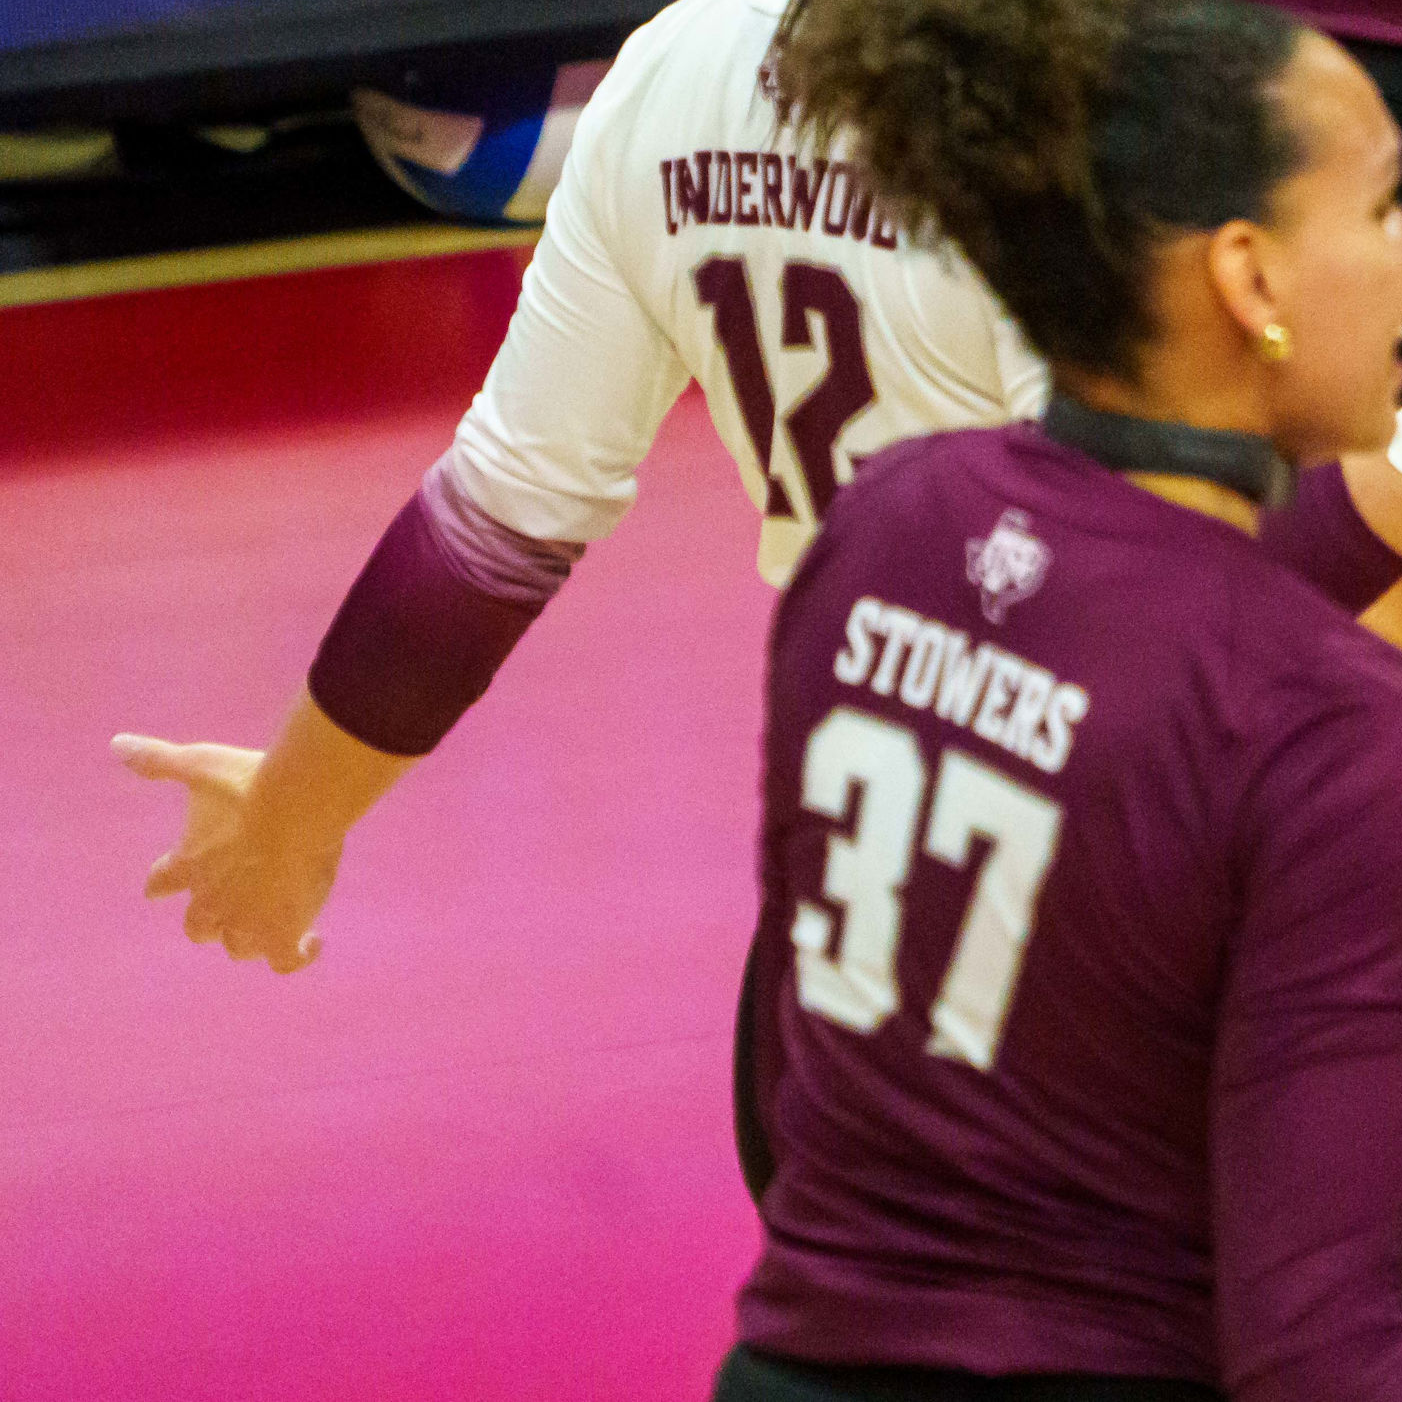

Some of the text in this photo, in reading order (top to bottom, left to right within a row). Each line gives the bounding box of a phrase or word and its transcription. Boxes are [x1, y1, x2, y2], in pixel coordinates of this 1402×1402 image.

[690, 251, 880, 523] 12
[834, 596, 1091, 774] STOWERS
[791, 705, 1064, 1071] 37
